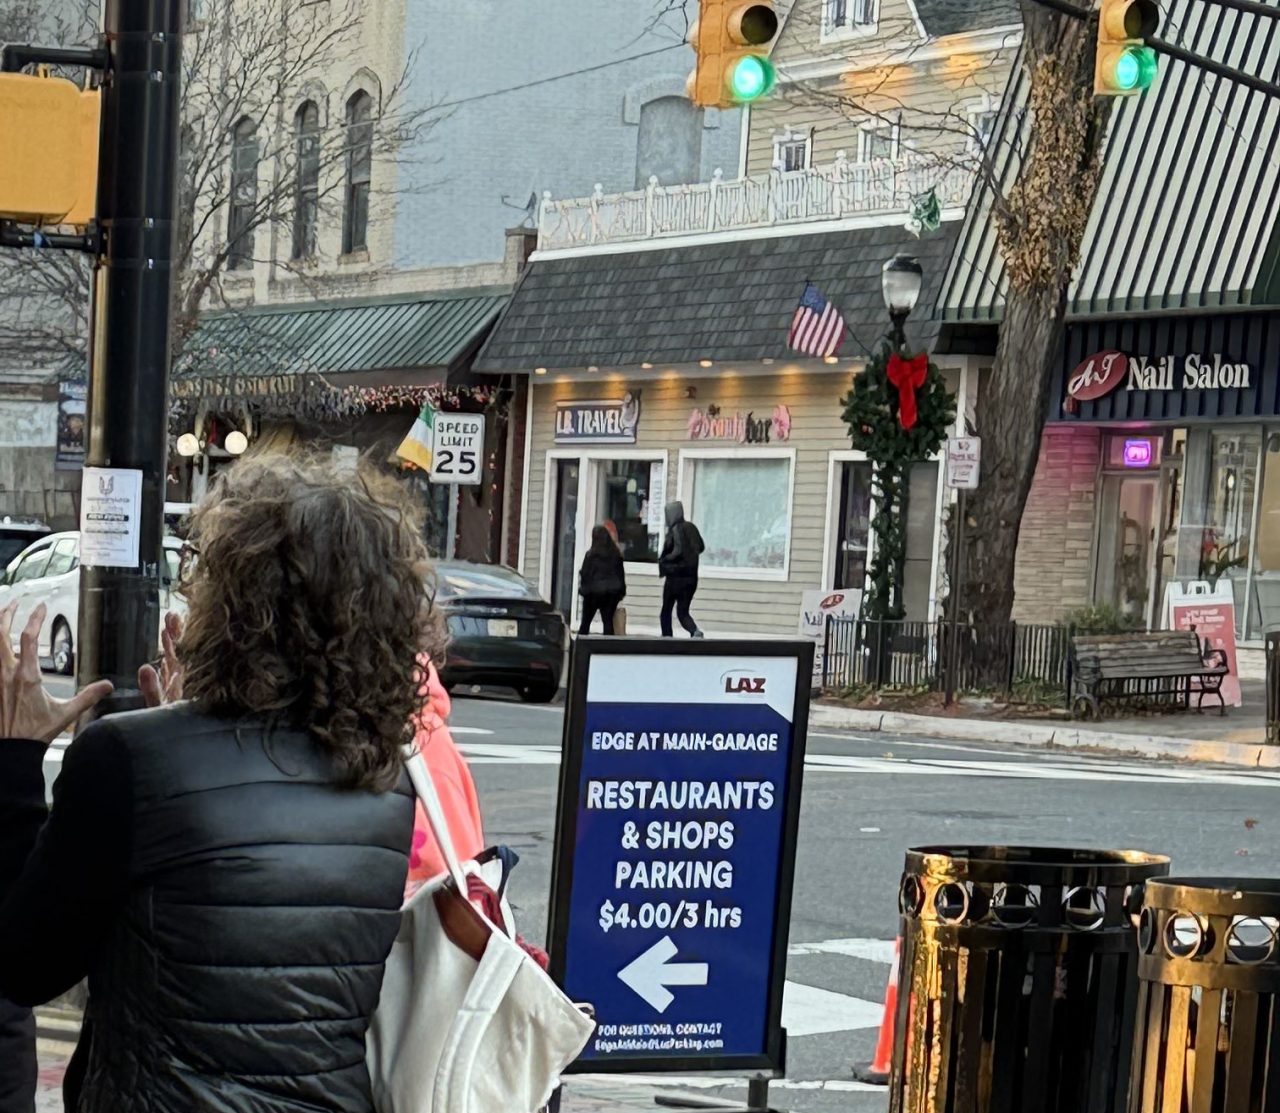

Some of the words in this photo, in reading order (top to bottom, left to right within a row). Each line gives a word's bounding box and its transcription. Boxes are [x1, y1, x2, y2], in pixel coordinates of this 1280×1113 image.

[1126, 355, 1175, 391] Nail
[1183, 353, 1250, 389] Salon
[438, 422, 479, 434] SPEED
[577, 410, 621, 434] TRAVEL
[440, 436, 473, 447] LIMIT
[435, 450, 476, 475] 25
[725, 676, 766, 693] LAZ
[591, 732, 635, 751] EDGE
[637, 732, 661, 751] AT
[663, 732, 778, 751] MAIN-GARAGE
[586, 780, 775, 811] RESTAURANTS
[621, 820, 640, 850] &
[645, 820, 735, 850] SHOPS
[615, 860, 733, 889] PARKING
[598, 899, 699, 933] $4.00/3
[704, 899, 742, 928] hrs
